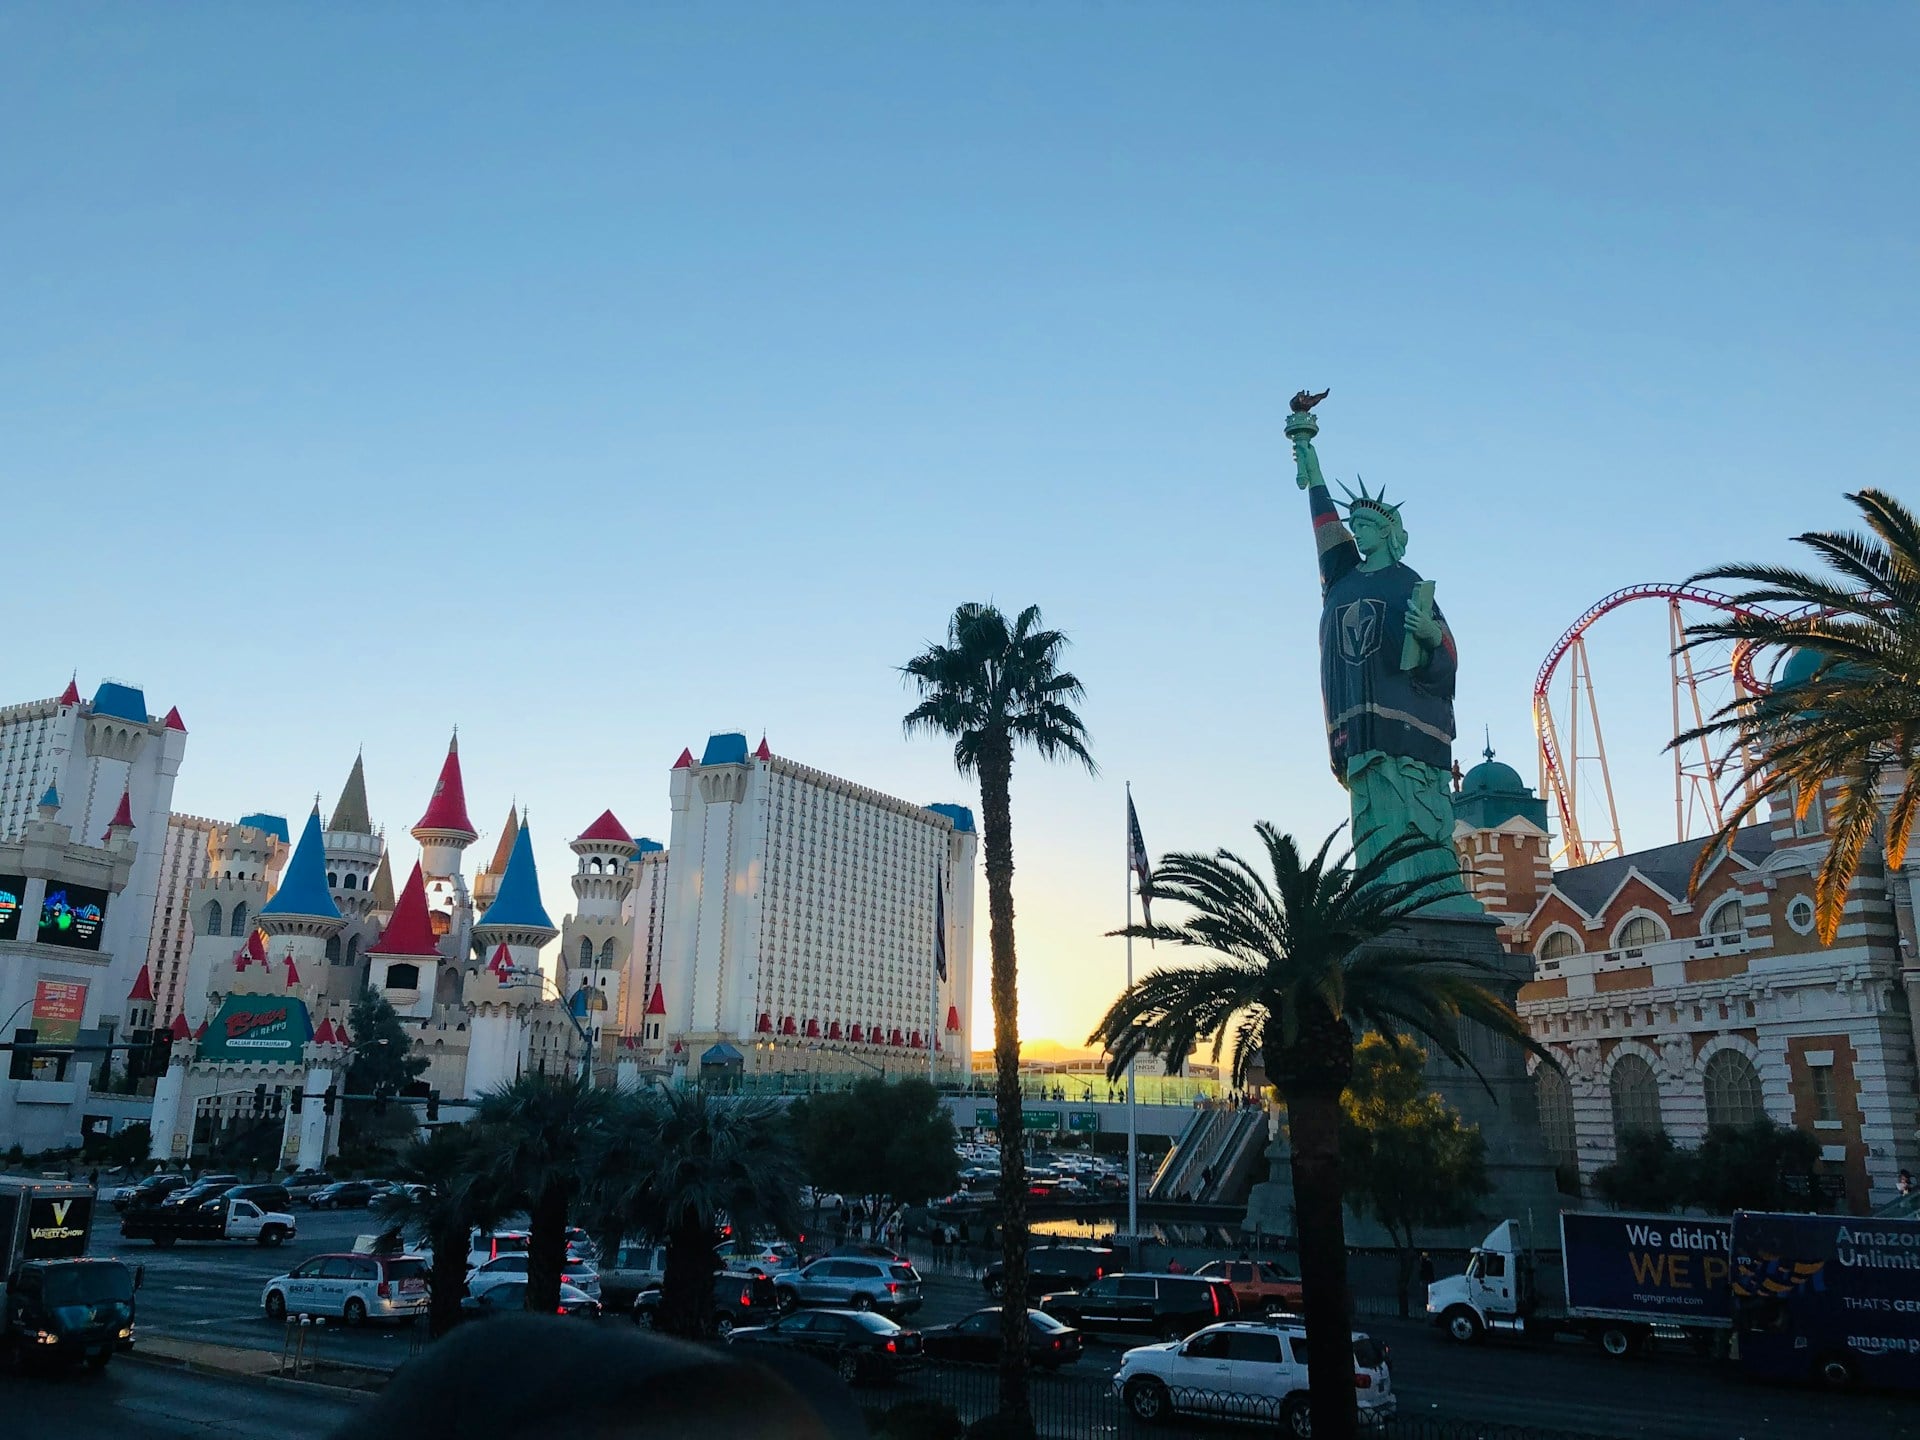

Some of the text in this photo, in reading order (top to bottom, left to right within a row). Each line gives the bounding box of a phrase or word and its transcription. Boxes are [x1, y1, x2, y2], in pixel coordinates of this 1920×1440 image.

[1625, 1223, 1730, 1251] We didn't
[1628, 1250, 1693, 1289] WE
[1632, 1292, 1704, 1306] mgmgrand.com
[1843, 1297, 1891, 1312] THAT'S
[1847, 1335, 1906, 1349] amazon
